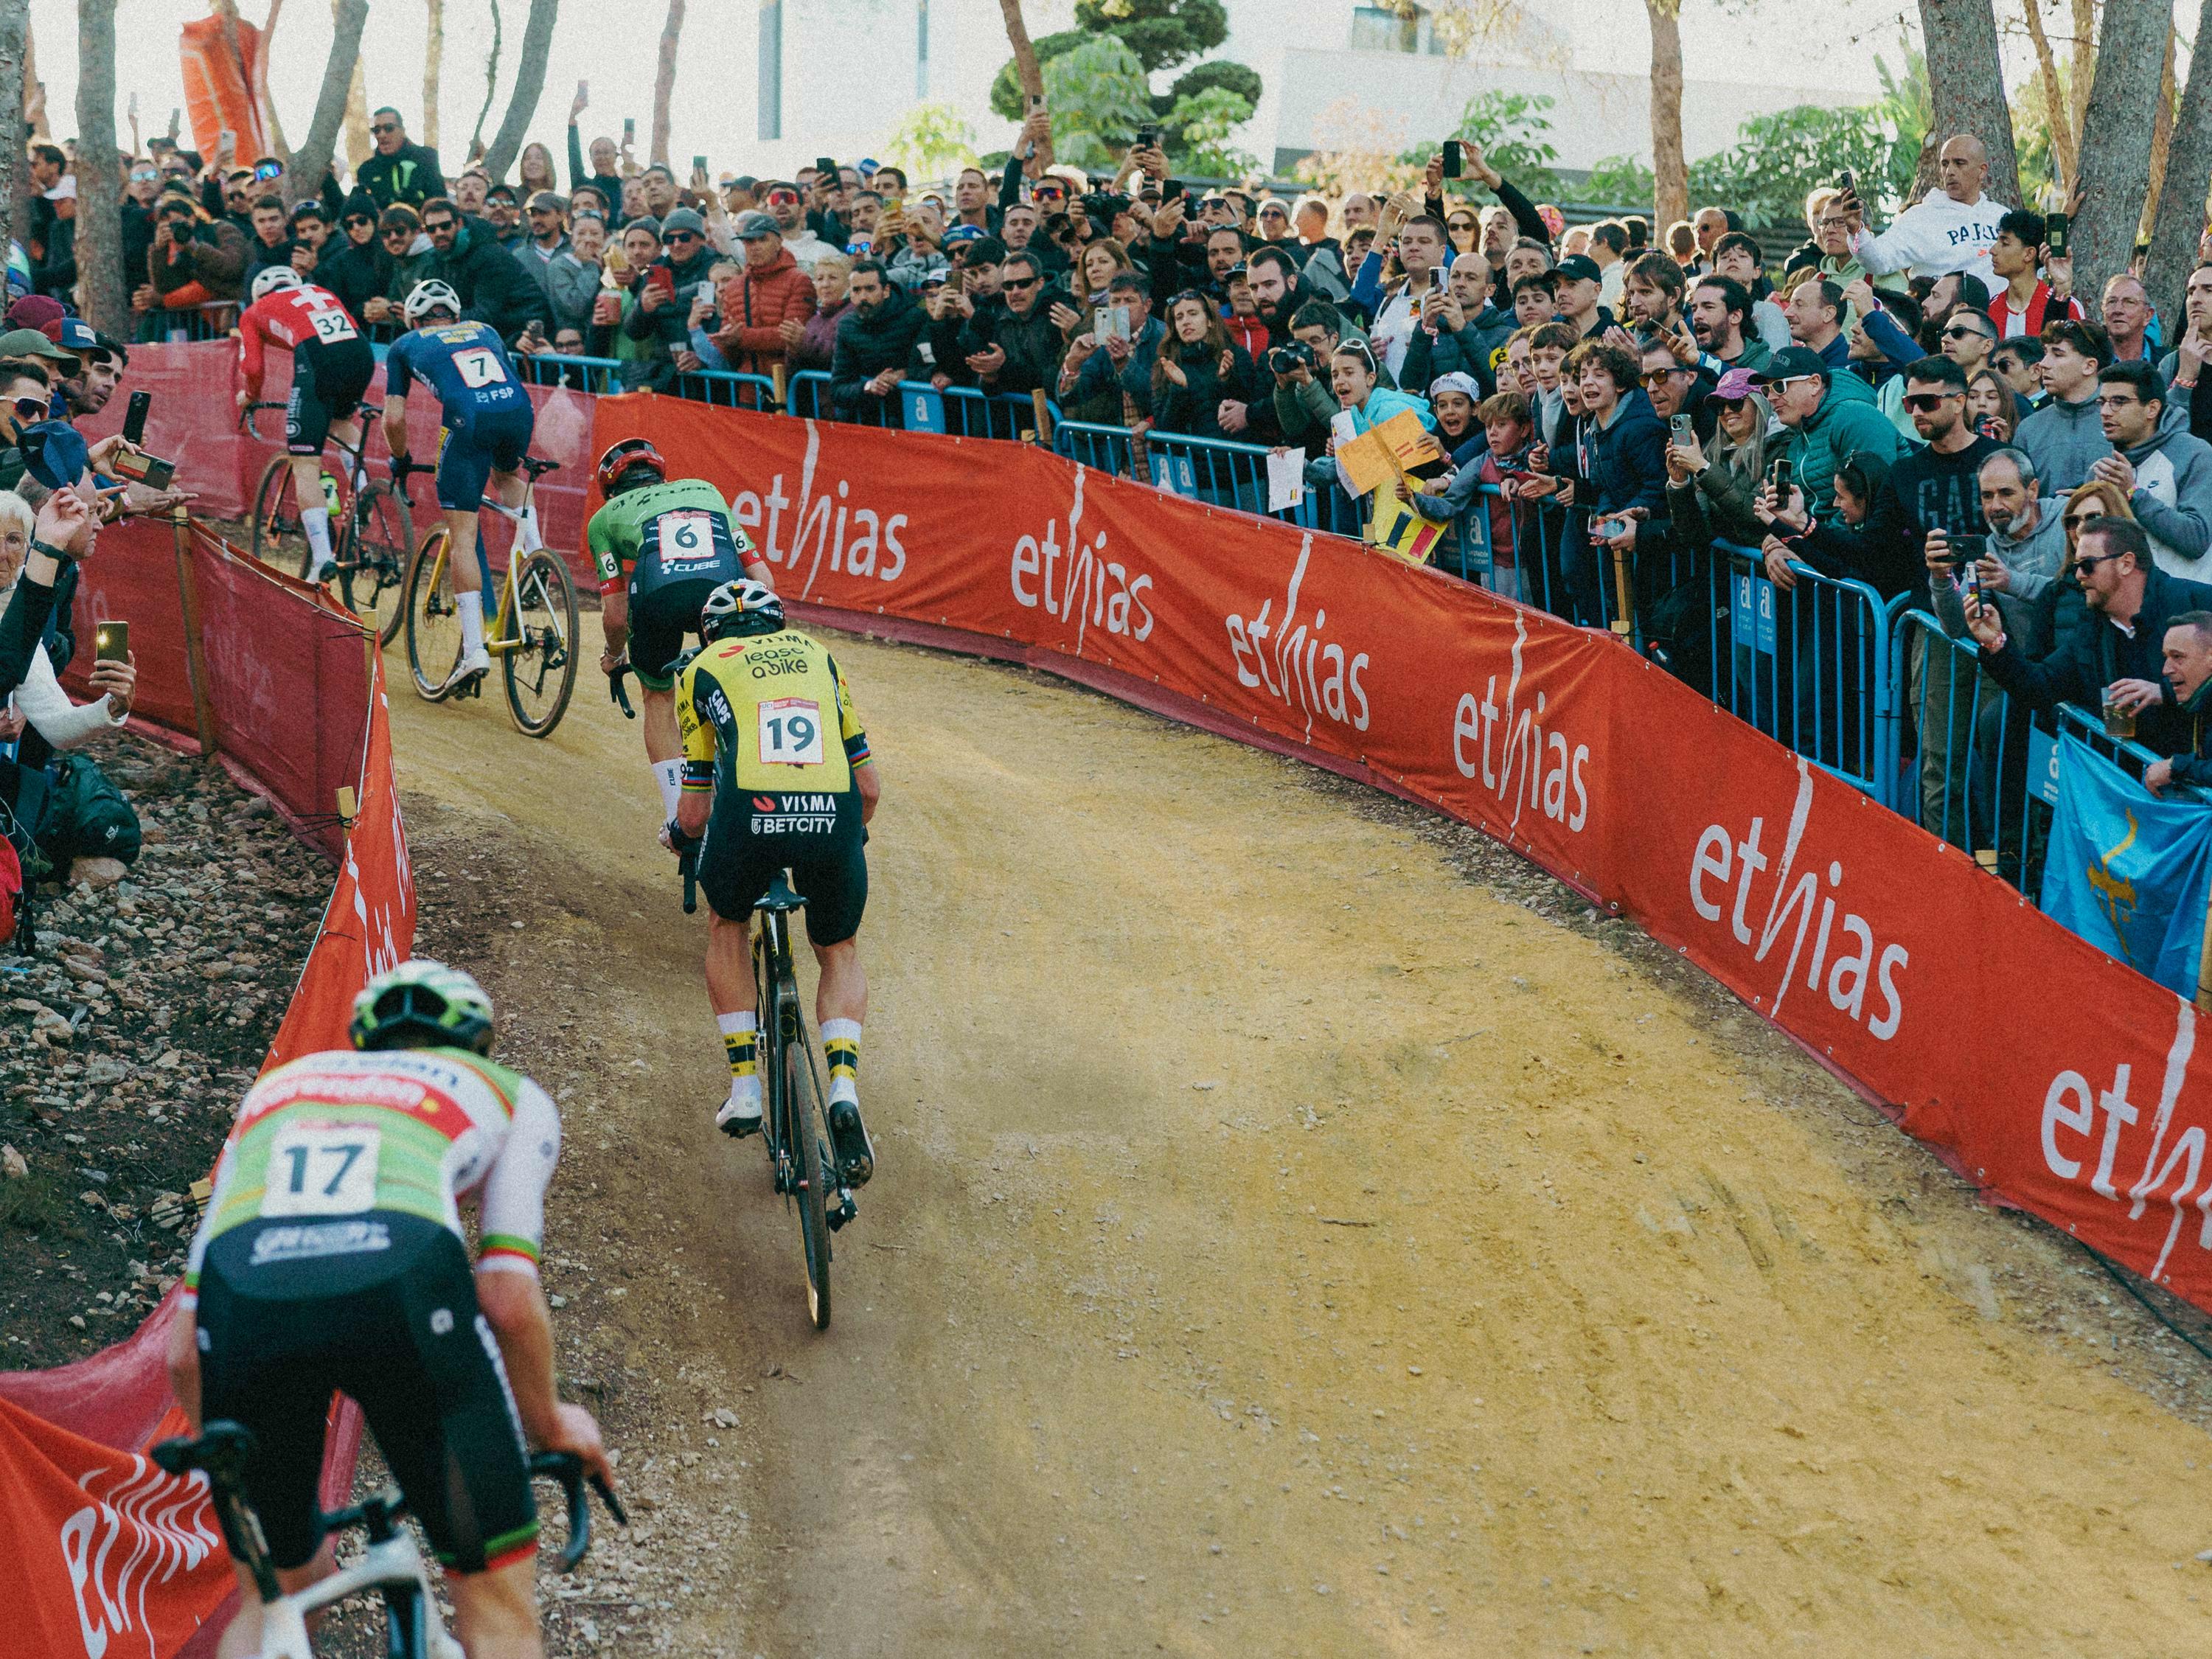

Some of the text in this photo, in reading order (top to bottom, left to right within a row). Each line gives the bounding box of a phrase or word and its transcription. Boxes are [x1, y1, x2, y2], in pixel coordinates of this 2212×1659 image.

[316, 314, 352, 336] 32
[470, 357, 486, 378] 7
[490, 387, 515, 401] FSP
[732, 418, 908, 601] ethias
[675, 523, 698, 549] 6
[735, 535, 745, 549] 6
[605, 558, 616, 572] 6
[674, 560, 720, 572] CUBE
[1011, 462, 1154, 656] ethias
[1225, 532, 1370, 744] ethias
[745, 647, 804, 665] lease
[712, 689, 731, 725] CAPS
[767, 715, 815, 753] 19
[1453, 609, 1590, 843] ethias
[667, 767, 676, 787] CUBE
[781, 794, 837, 812] VISMA
[763, 817, 837, 834] BETCITY
[1689, 755, 1909, 1040] ethias
[284, 1144, 366, 1196] 17
